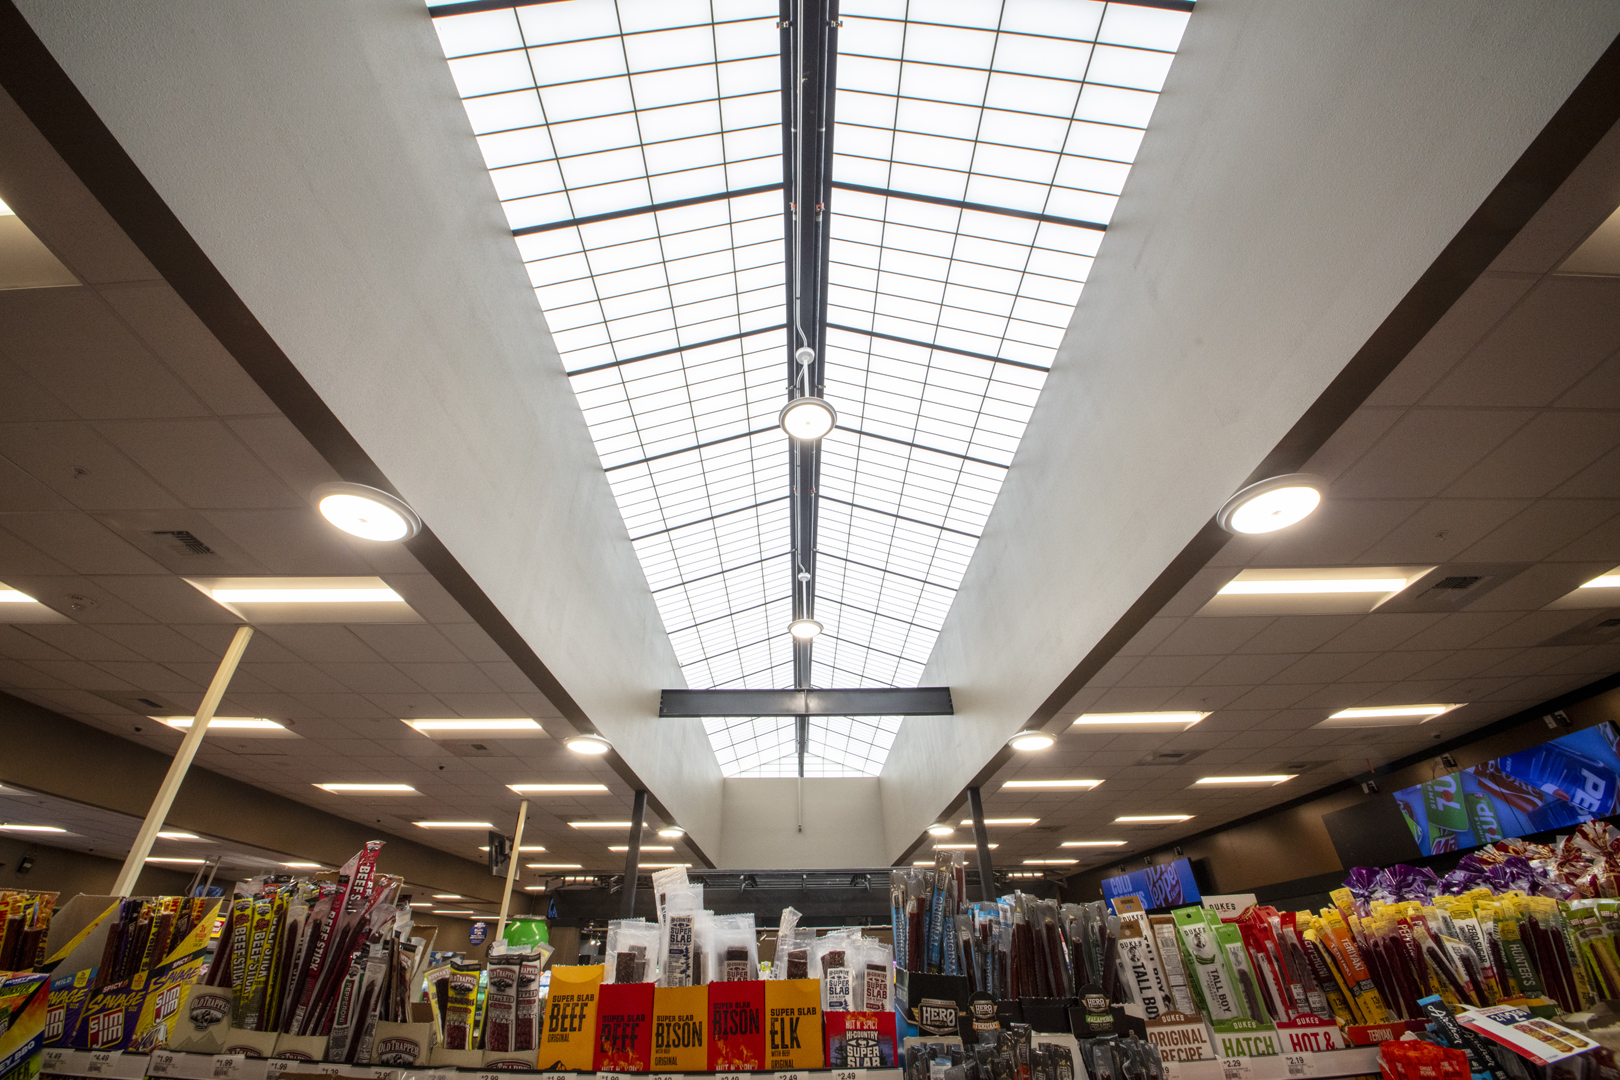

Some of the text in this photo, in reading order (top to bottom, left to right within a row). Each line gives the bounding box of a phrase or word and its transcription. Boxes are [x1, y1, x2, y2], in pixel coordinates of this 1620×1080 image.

[1476, 803, 1502, 844] 7UP
[353, 865, 371, 895] BEEF
[1110, 875, 1133, 896] COLD
[931, 896, 944, 946] ORIGINAL
[670, 927, 692, 935] SUPER
[670, 934, 692, 943] SLAB
[308, 911, 336, 972] BEEF STICK
[1466, 924, 1488, 964] ZERO SUGAR
[172, 956, 188, 969] SPICY
[232, 926, 247, 987] BEEF STICK
[1340, 937, 1365, 972] TERIYAKI
[1509, 944, 1536, 988] HUNTER'S
[54, 976, 72, 987] MILD
[866, 981, 888, 990] SUPER
[1132, 962, 1152, 994] TALL
[102, 980, 122, 993] SPICY
[828, 986, 850, 995] SLAB
[866, 988, 888, 1000] SLAB
[1210, 968, 1232, 1013] TALL BOY
[81, 991, 146, 1017] SAVAGE
[156, 986, 180, 1008] slim
[191, 996, 230, 1011] OLD TRAPPER
[340, 982, 352, 1023] PEPPERONI
[552, 994, 595, 1002] SUPER SLAB
[1086, 998, 1106, 1008] HERO
[157, 998, 178, 1022] jim
[713, 1002, 733, 1010] SUPER
[770, 1006, 816, 1017] SUPER SLAB
[975, 1004, 993, 1014] HERO
[90, 1012, 122, 1034] slim
[548, 1002, 588, 1032] BEEF
[627, 1014, 646, 1022] SLAB
[678, 1014, 694, 1022] SLAB
[712, 1008, 760, 1036] BISON
[922, 1006, 956, 1026] HERO
[846, 1020, 856, 1029] HOT
[863, 1020, 878, 1030] SPICY
[974, 1022, 998, 1030] TERIYAKI
[1427, 1005, 1462, 1044] Archer
[92, 1025, 122, 1048] jim
[548, 1033, 570, 1042] ORIGINAL
[600, 1022, 640, 1054] BEEF
[655, 1021, 702, 1048] BISON
[770, 1016, 802, 1050] ELK
[846, 1030, 878, 1040] HI-COUNTRY
[1149, 1028, 1207, 1047] ORIGINAL
[1367, 1028, 1394, 1042] TERIYAKI
[378, 1039, 419, 1053] OLD TRAPPER
[1222, 1036, 1276, 1058] HATCH
[1289, 1031, 1336, 1052] HOT &
[14, 1040, 36, 1061] BBQ
[771, 1050, 781, 1058] WITH
[846, 1046, 880, 1058] SUPER
[1160, 1046, 1203, 1062] RECIPE
[654, 1056, 678, 1066] ORIGINAL
[770, 1059, 794, 1069] ORIGINAL
[847, 1056, 880, 1068] SLAB
[838, 1072, 856, 1080] $2.49
